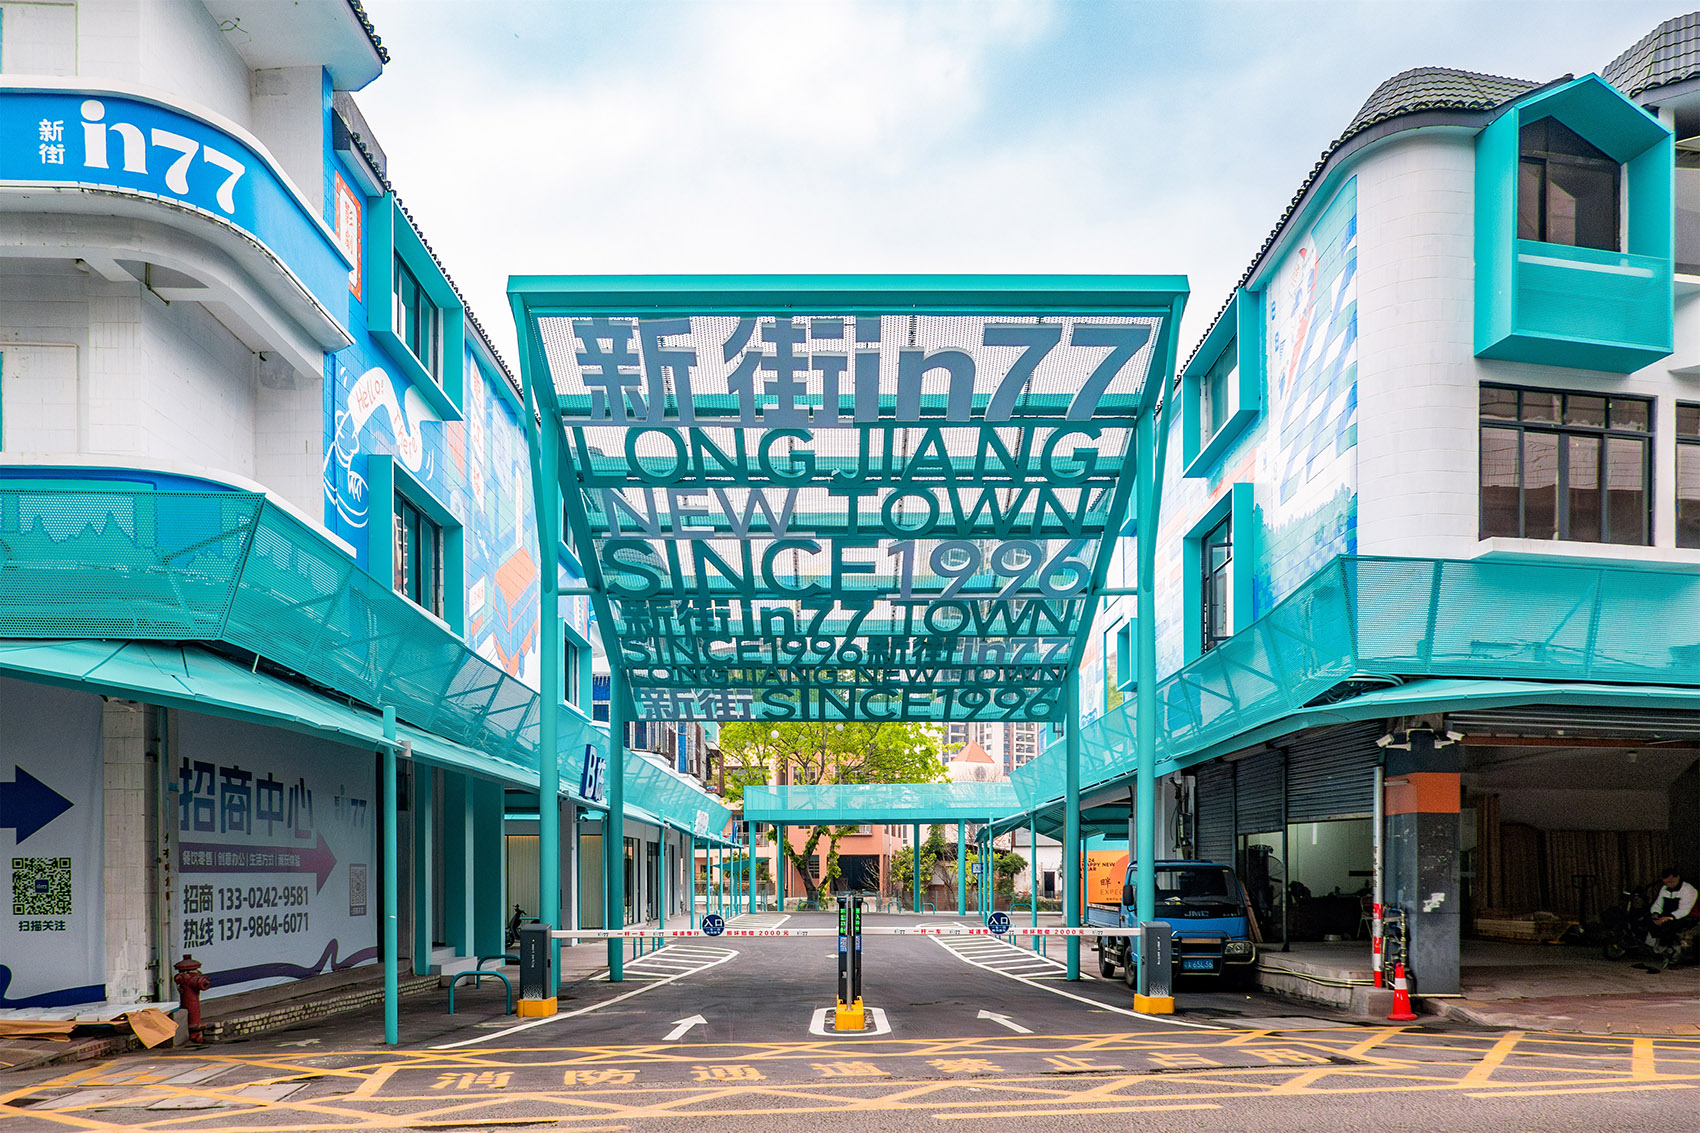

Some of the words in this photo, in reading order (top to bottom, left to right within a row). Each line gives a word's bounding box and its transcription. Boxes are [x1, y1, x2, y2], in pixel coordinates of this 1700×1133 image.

[39, 118, 66, 165] 新街
[80, 100, 246, 215] in77
[355, 379, 384, 414] Hello!
[600, 486, 800, 539] NEW
[828, 486, 1092, 539] TOWN
[898, 600, 1076, 636] TOWN
[854, 665, 940, 686] NEW
[956, 665, 1065, 686] TOWN
[180, 757, 313, 839] 招商中心
[184, 884, 214, 914] 招商
[218, 886, 309, 911] 133-0242-9581
[19, 920, 66, 932] 扫描关注
[184, 917, 214, 948] 热线
[218, 912, 309, 941] 137-9864-6071
[704, 918, 723, 927] 入口
[989, 916, 1008, 925] 入口
